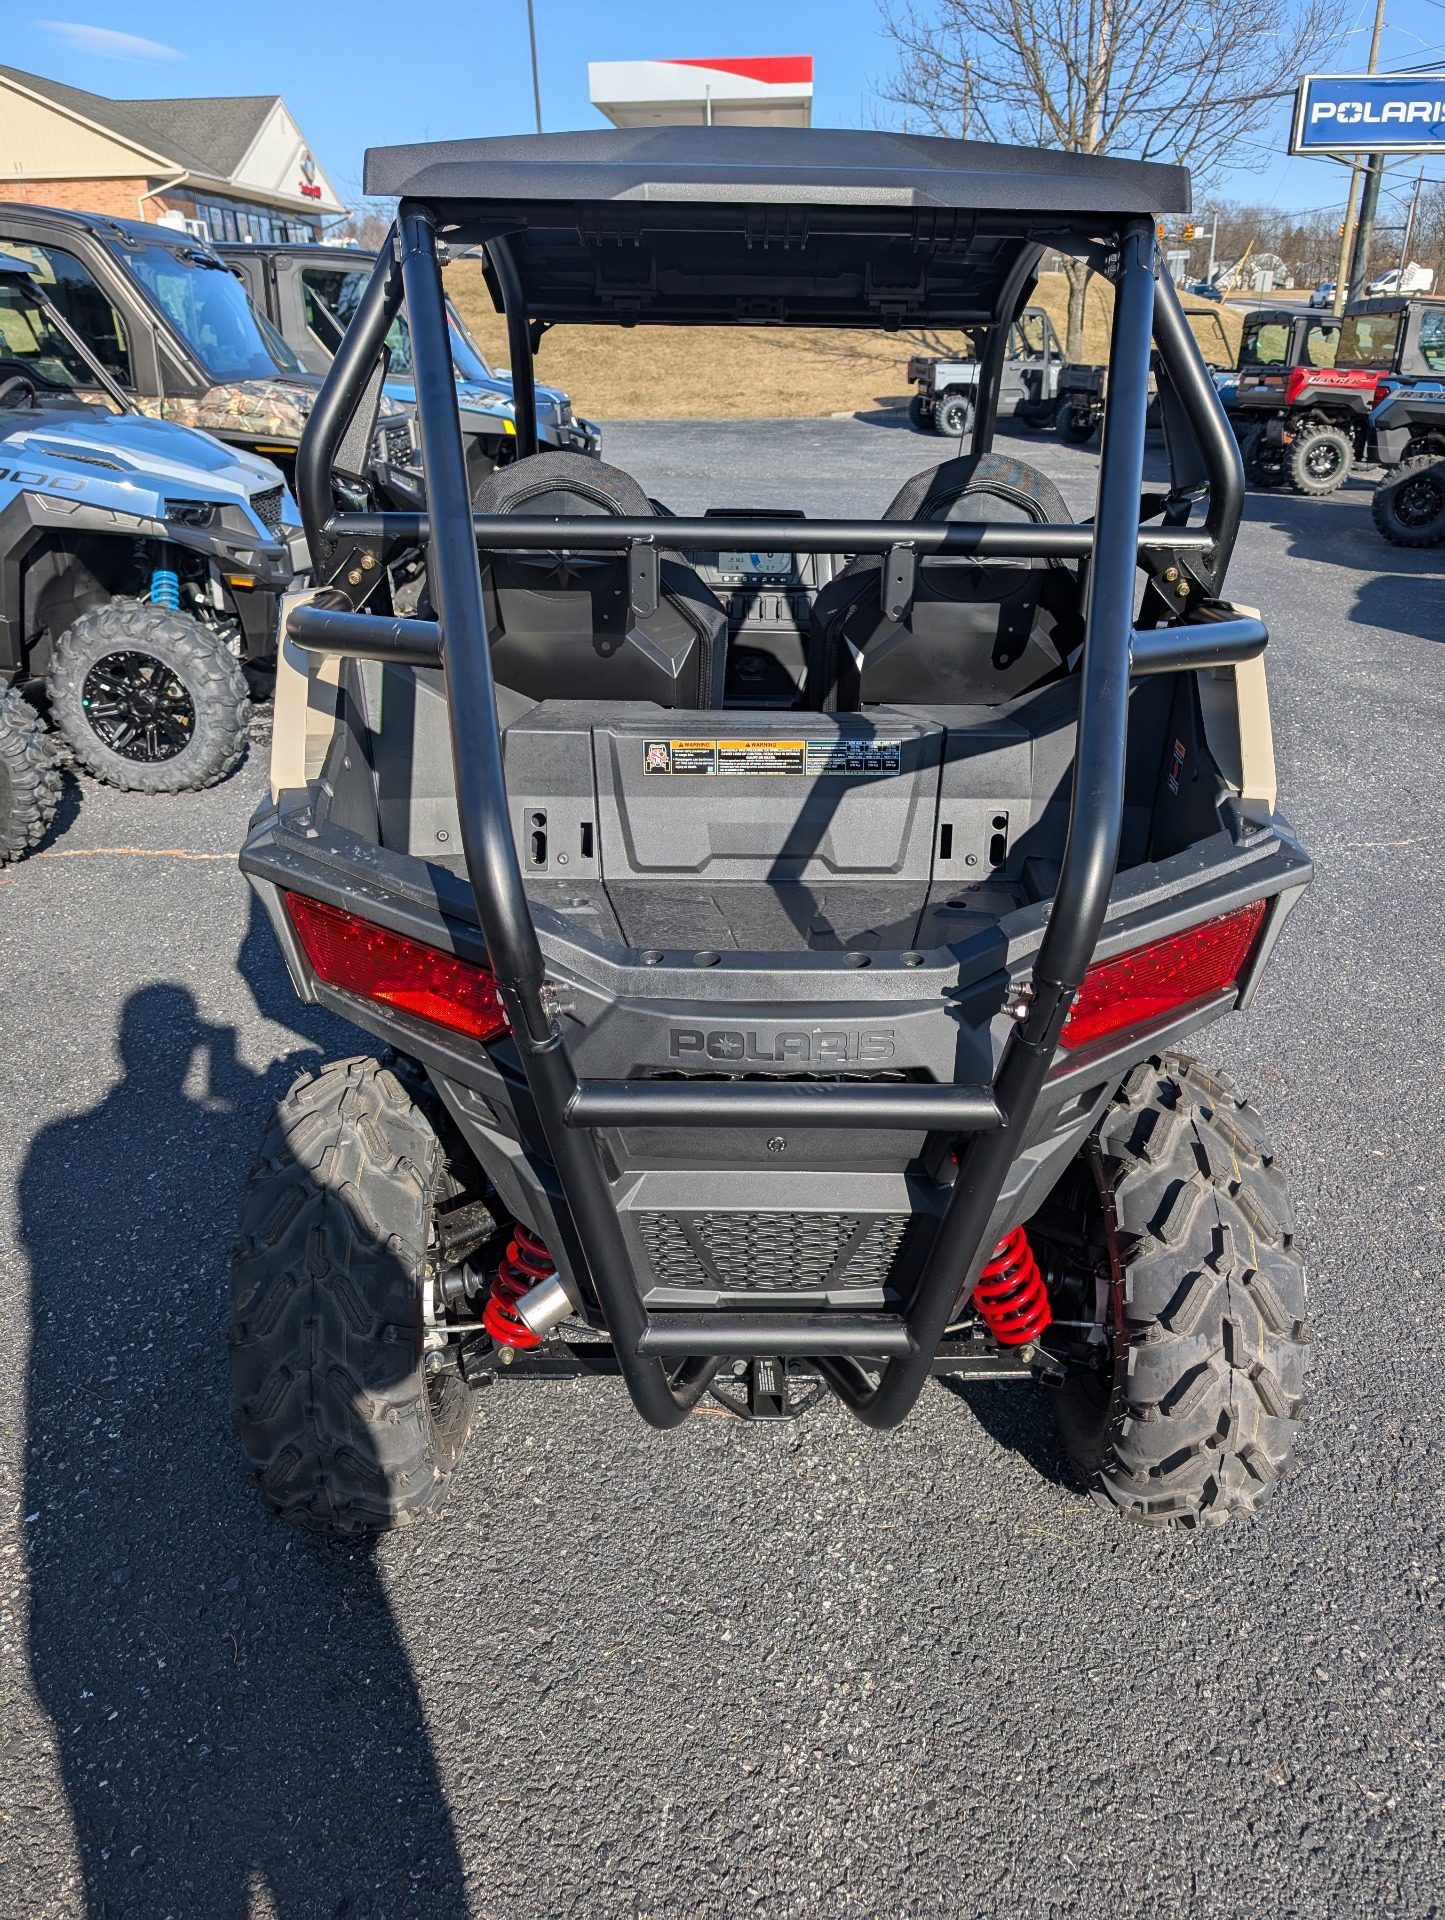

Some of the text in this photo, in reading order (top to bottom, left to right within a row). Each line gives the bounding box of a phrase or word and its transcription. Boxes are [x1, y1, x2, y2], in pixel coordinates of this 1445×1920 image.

[1311, 101, 1445, 124] POLARI
[0, 468, 88, 491] 00
[669, 1028, 896, 1062] POLARIS
